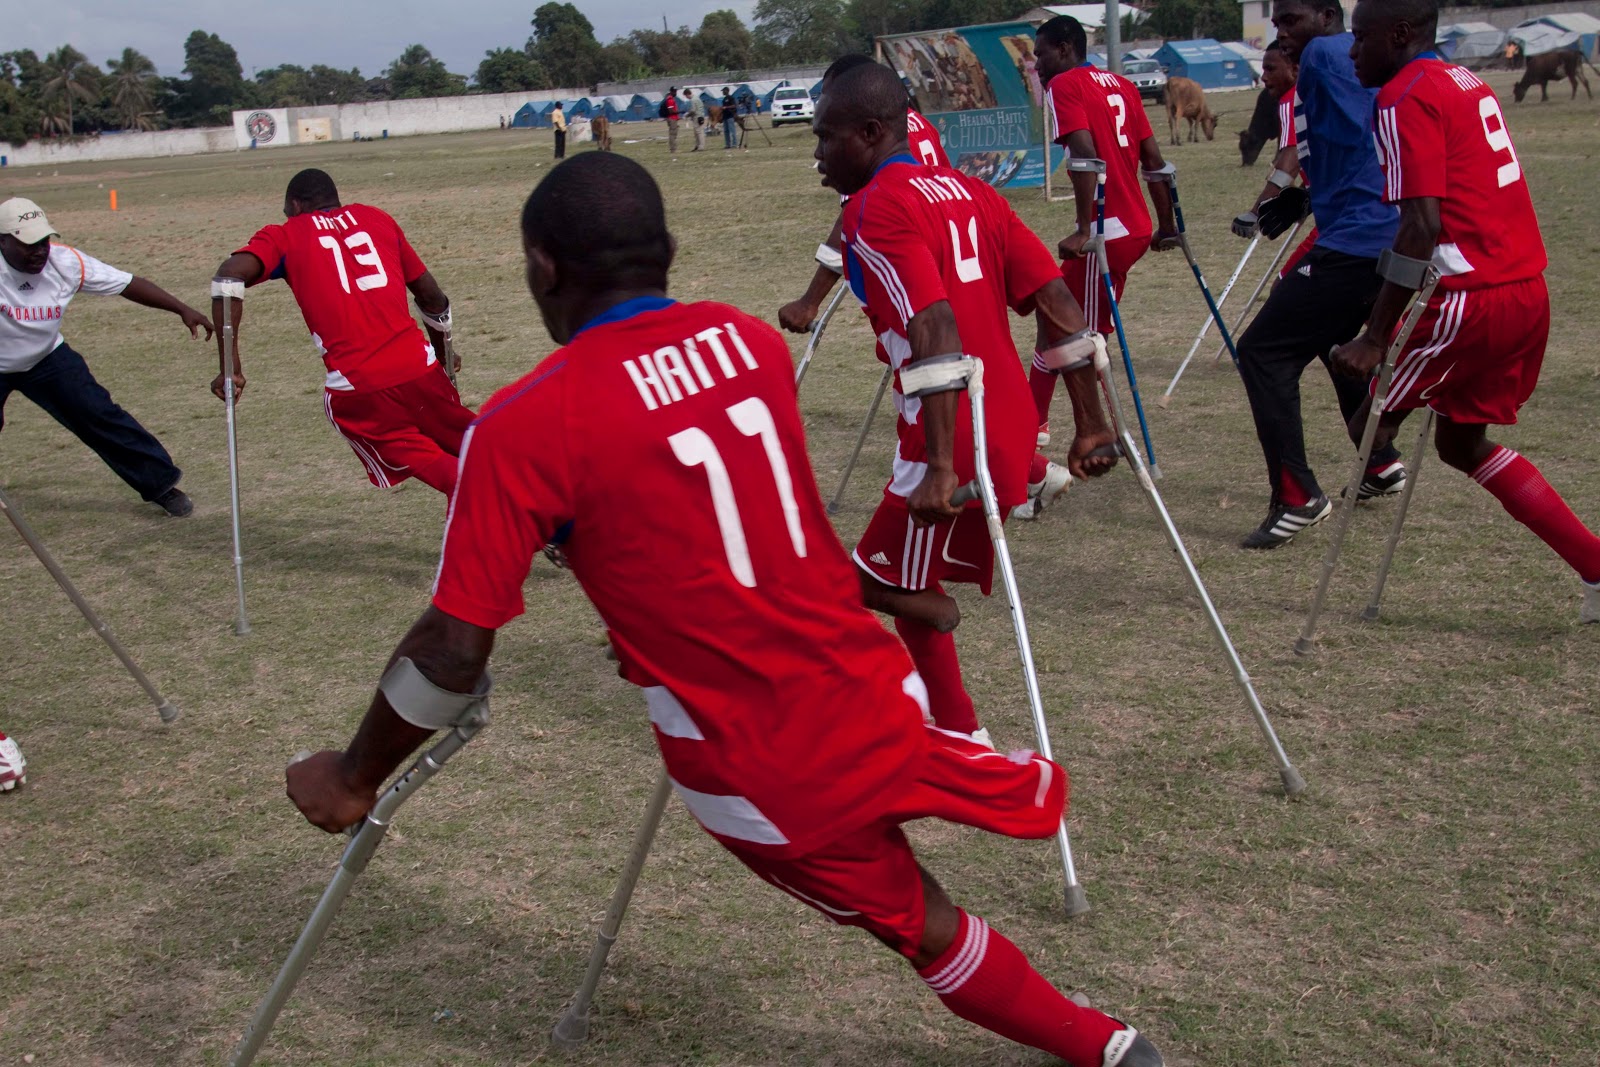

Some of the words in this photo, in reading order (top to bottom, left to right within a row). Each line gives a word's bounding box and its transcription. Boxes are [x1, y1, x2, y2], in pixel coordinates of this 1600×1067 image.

[1444, 65, 1483, 91] HAIT
[948, 123, 1029, 149] CHILDREN
[1107, 94, 1129, 147] 2
[1479, 95, 1521, 189] 9
[311, 210, 359, 234] HATI
[318, 231, 388, 294] 13
[15, 304, 62, 321] DALLAS
[622, 322, 760, 411] HAITI
[667, 396, 808, 588] 11
